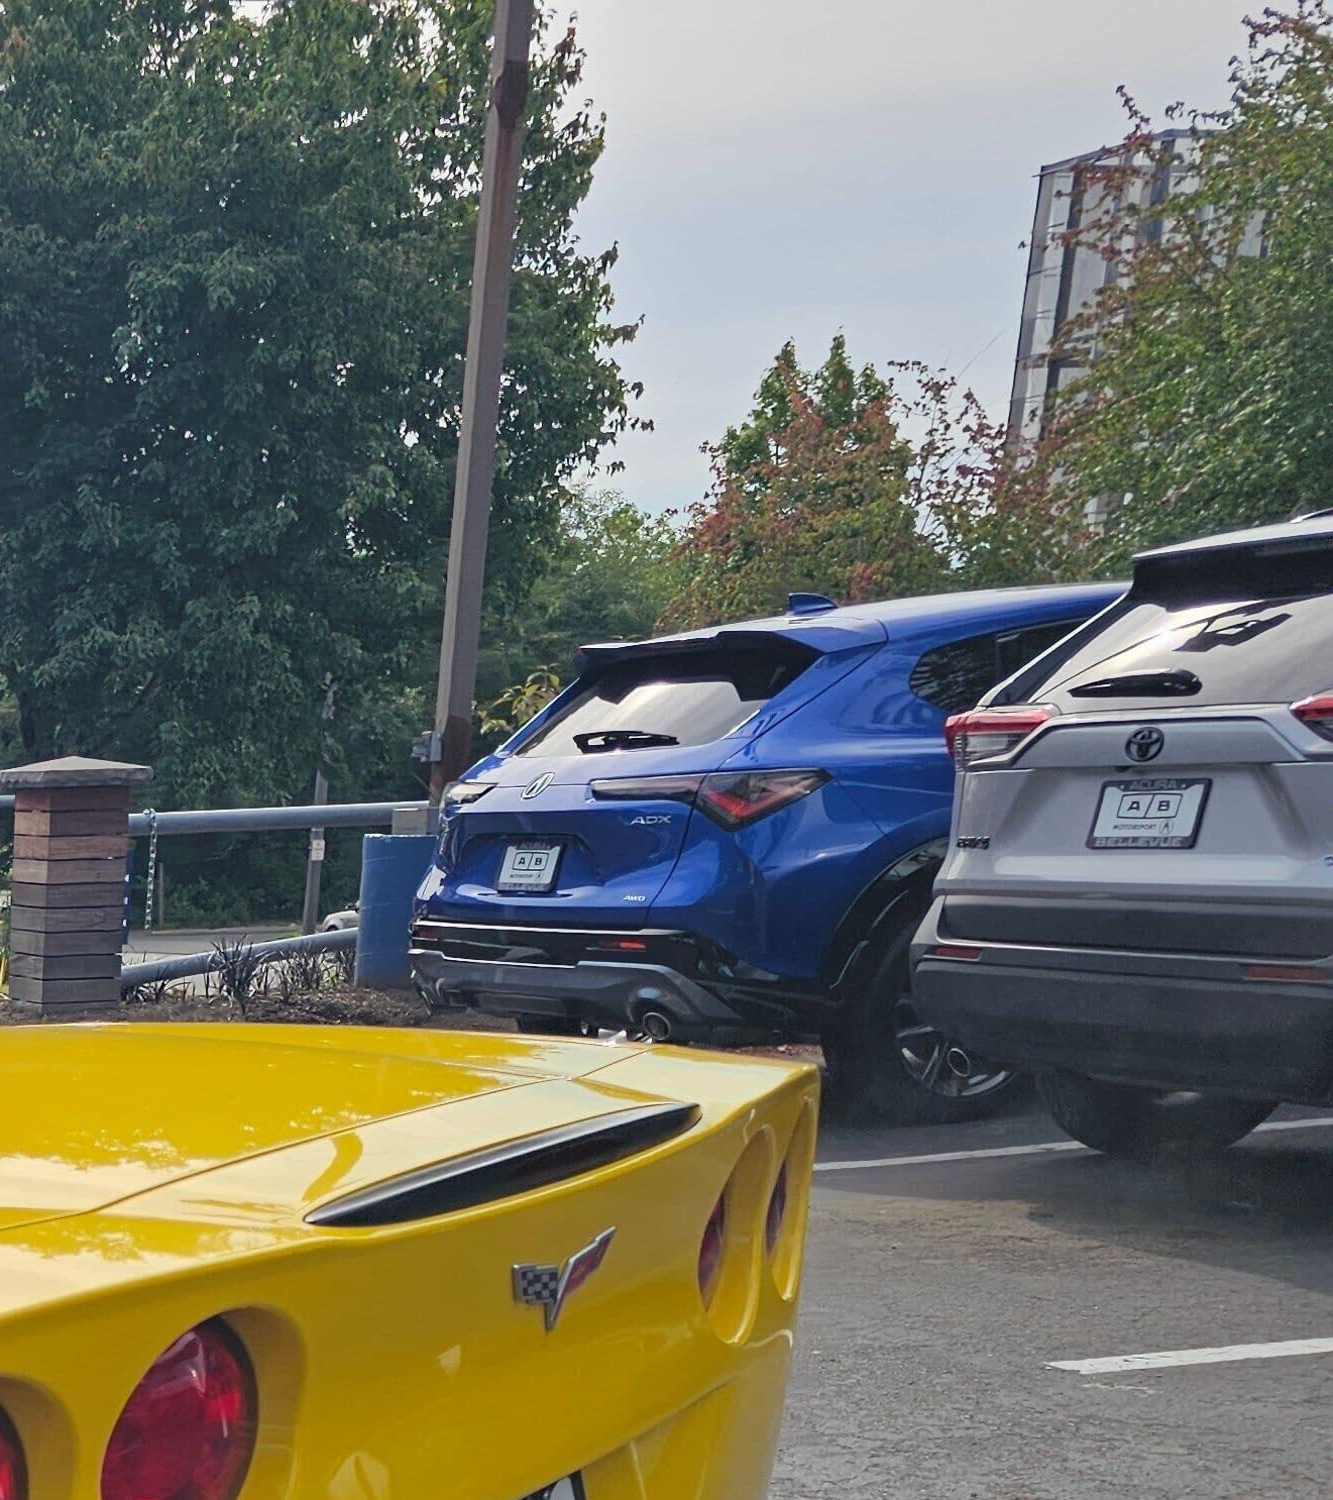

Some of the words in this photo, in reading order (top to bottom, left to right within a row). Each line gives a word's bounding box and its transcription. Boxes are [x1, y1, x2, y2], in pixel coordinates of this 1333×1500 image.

[1128, 779, 1179, 790] ACURA
[1127, 800, 1141, 811] A
[1157, 800, 1171, 812] B
[630, 815, 672, 825] ADX
[1094, 837, 1183, 848] BELLEVUE
[517, 857, 526, 865] A
[534, 857, 543, 865] B
[622, 894, 647, 902] AWD
